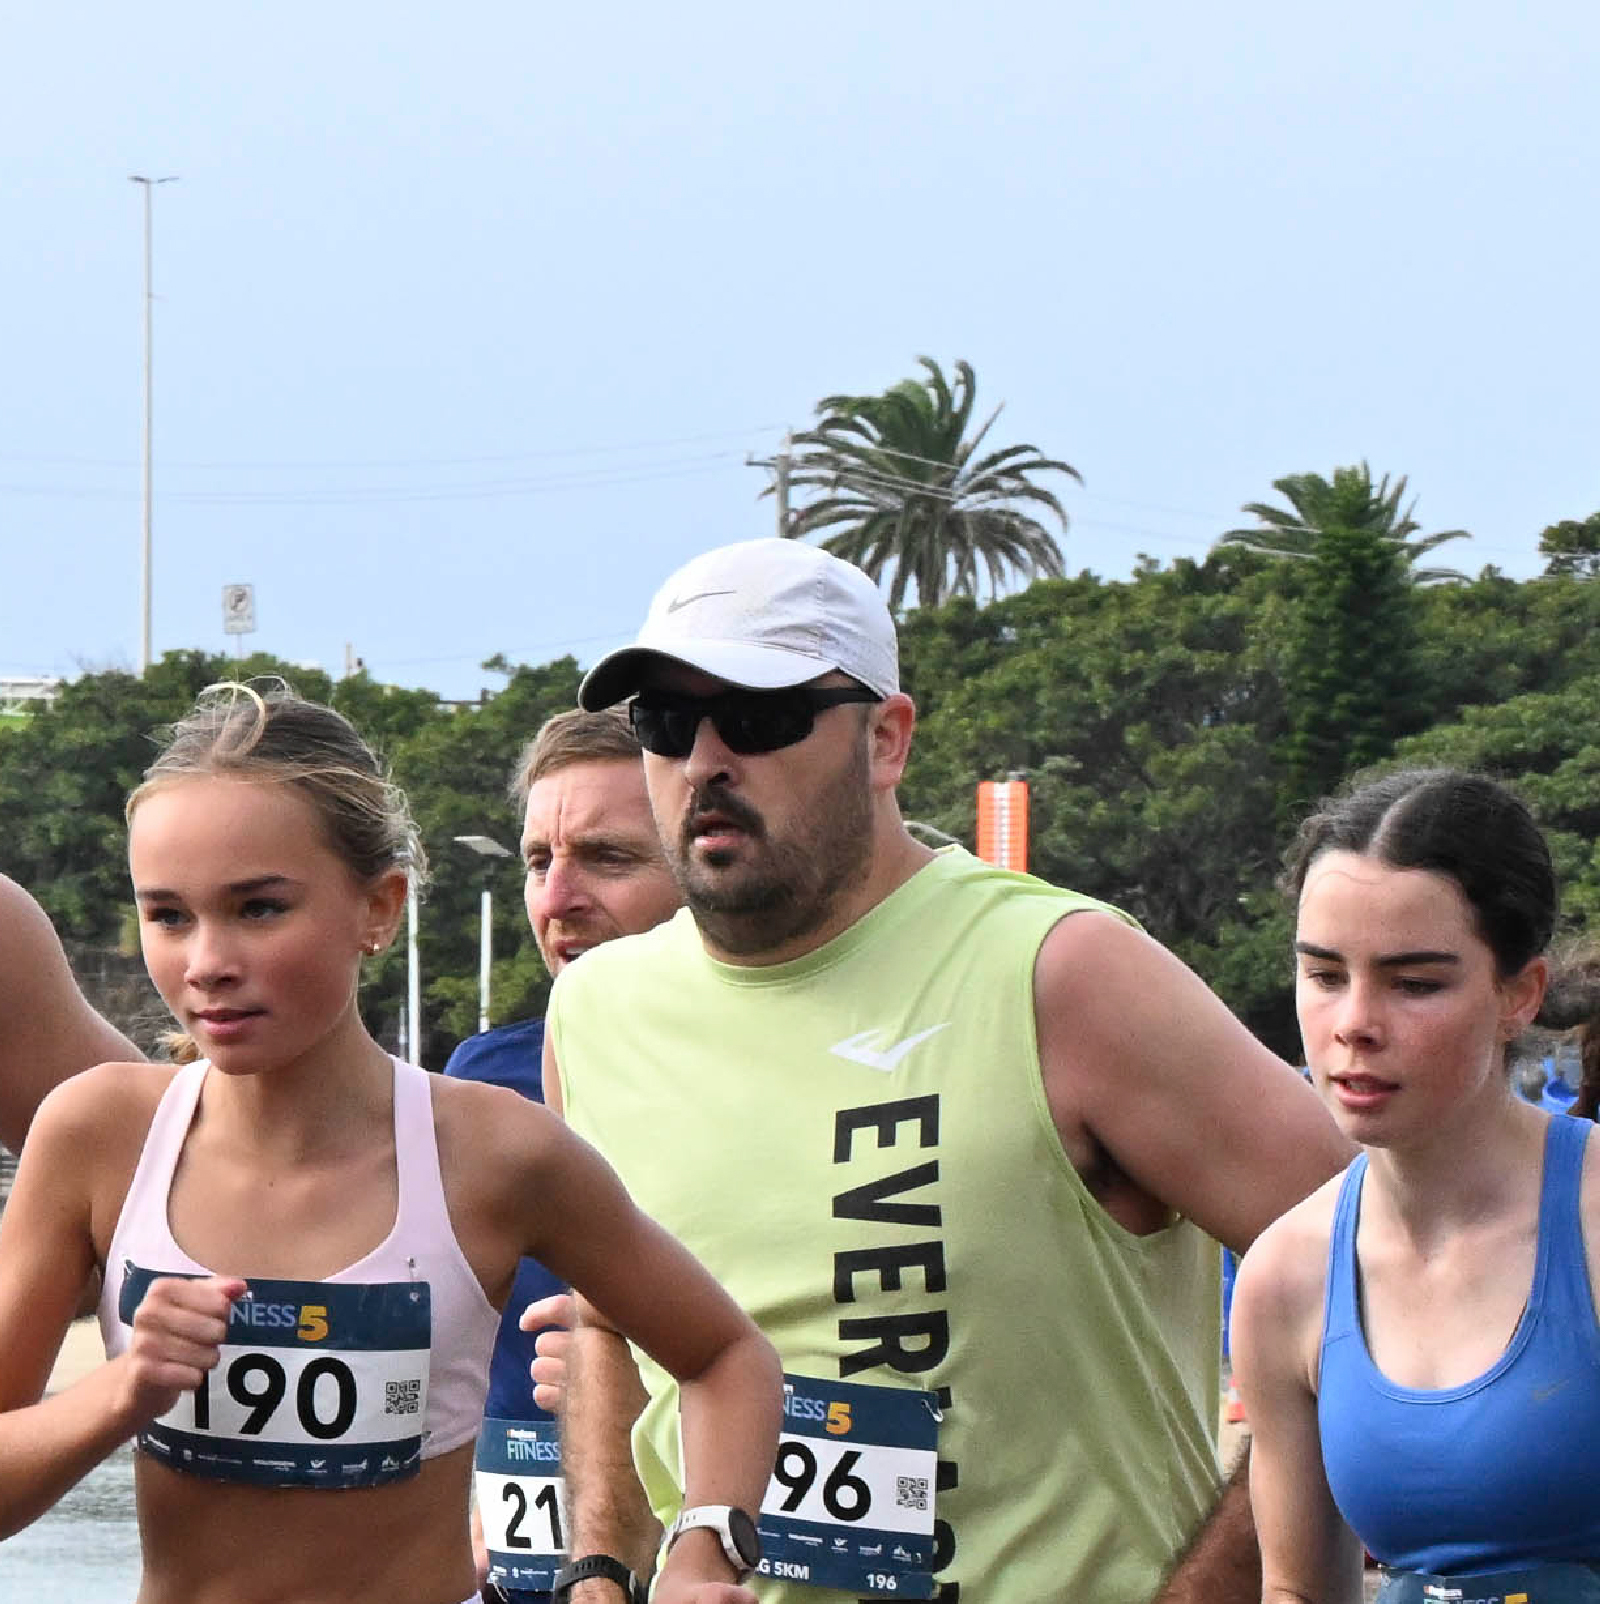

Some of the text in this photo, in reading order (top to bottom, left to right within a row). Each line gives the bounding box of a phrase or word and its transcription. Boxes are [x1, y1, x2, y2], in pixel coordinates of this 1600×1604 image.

[229, 1302, 328, 1341] NESS 5
[195, 1352, 357, 1439] 190
[825, 1402, 853, 1435] 5
[507, 1441, 562, 1461] FITNESS
[774, 1441, 871, 1522] 96
[503, 1482, 563, 1550] 21
[774, 1562, 810, 1580] 5KM
[867, 1574, 897, 1590] 196
